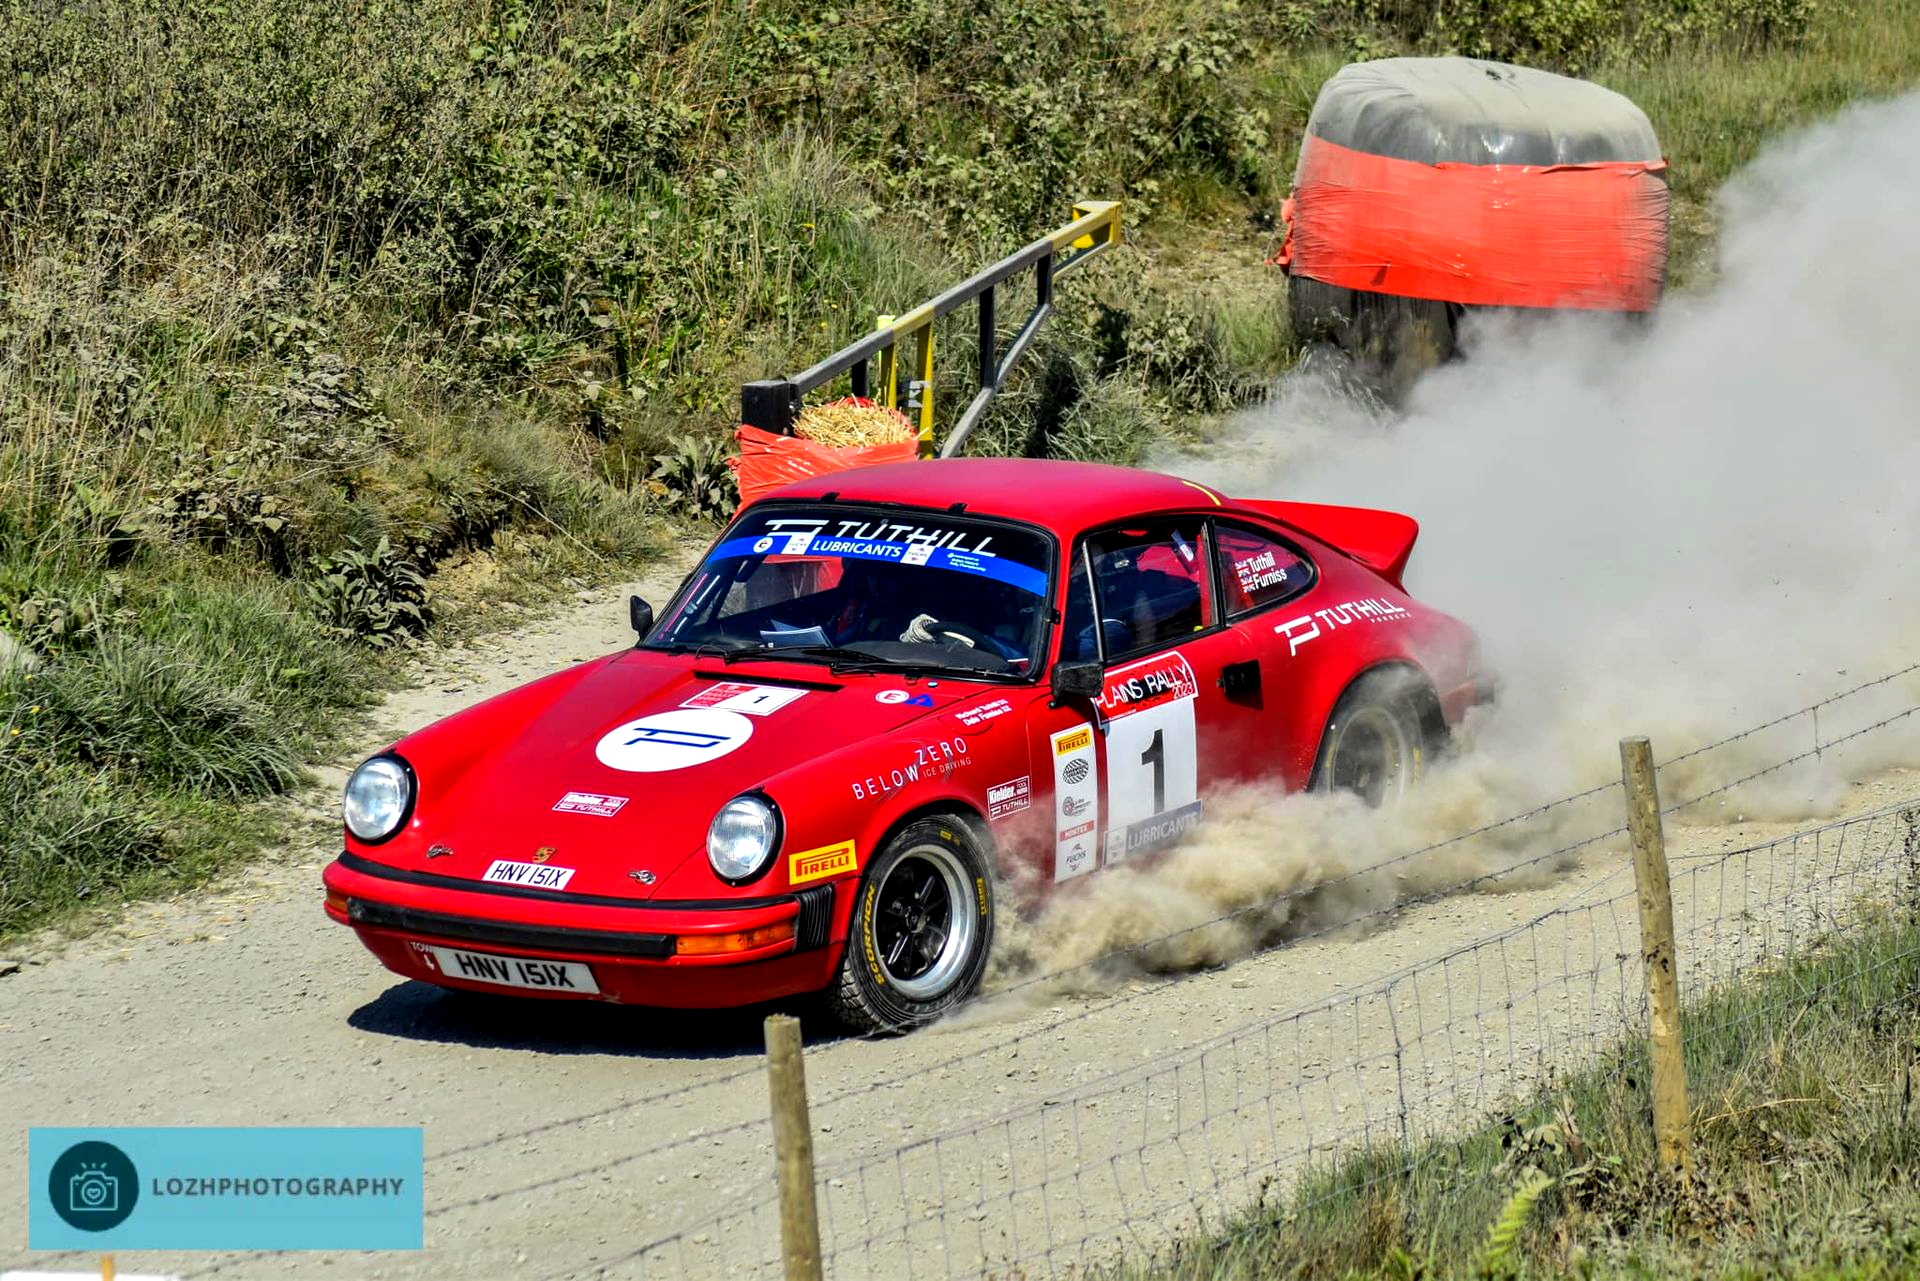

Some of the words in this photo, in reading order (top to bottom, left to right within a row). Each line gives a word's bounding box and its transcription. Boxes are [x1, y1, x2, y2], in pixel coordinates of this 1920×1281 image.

[812, 540, 903, 558] LUBRICANTS
[835, 520, 997, 557] TUTHILL
[1247, 551, 1276, 573] Tuthill
[1252, 567, 1288, 590] Furniss
[1315, 598, 1406, 630] TUTHILL
[1144, 663, 1190, 694] RALLY
[1172, 682, 1194, 700] 2023
[914, 737, 968, 765] ZERO
[1057, 732, 1090, 752] PIRELLI
[923, 767, 937, 778] ICE
[939, 756, 972, 774] DRIVING
[1141, 728, 1166, 815] 1
[852, 764, 919, 800] BELOW
[1002, 797, 1028, 812] TUTHILL
[1127, 811, 1198, 850] LUBRICANTS
[490, 863, 527, 882] HNV
[528, 866, 567, 887] 151X
[796, 847, 850, 877] PIRELLI
[863, 878, 886, 986] SCORPION
[410, 941, 434, 954] TOW
[454, 953, 510, 982] HNV
[517, 962, 575, 989] 151X
